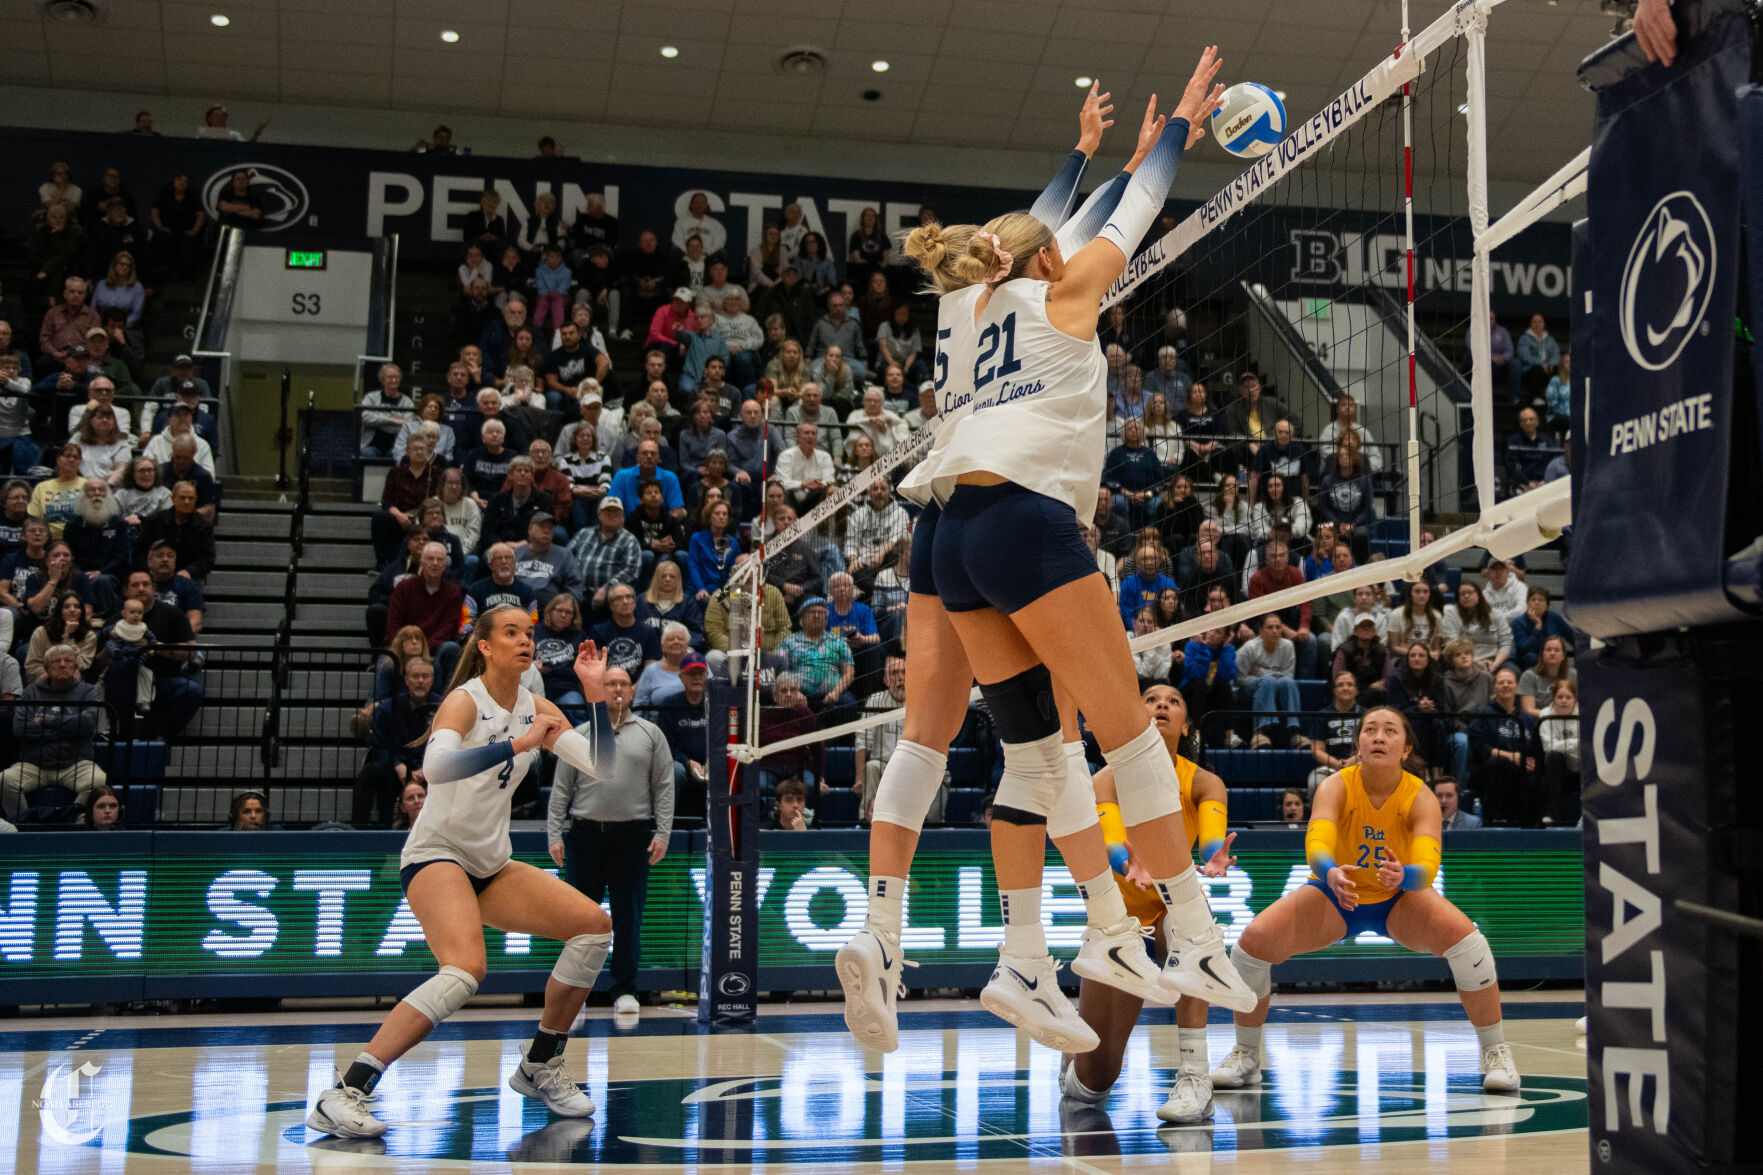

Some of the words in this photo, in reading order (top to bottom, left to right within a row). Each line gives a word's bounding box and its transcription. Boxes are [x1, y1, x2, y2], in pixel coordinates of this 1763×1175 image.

[1200, 184, 1233, 228] PENN
[1235, 152, 1275, 201] STATE
[1278, 79, 1372, 169] VOLLEYBALL
[367, 171, 619, 248] PENN
[291, 293, 321, 315] S3
[934, 327, 951, 392] 5
[974, 311, 1021, 393] 21
[944, 391, 973, 414] Lion
[996, 379, 1045, 406] Lions
[1610, 411, 1657, 456] PENN
[1658, 393, 1712, 441] STATE
[498, 756, 514, 789] 4
[1362, 825, 1385, 841] Pitt
[1357, 844, 1387, 869] 25
[730, 871, 742, 911] PENN
[1593, 697, 1671, 1135] STATE
[729, 915, 742, 960] STATE
